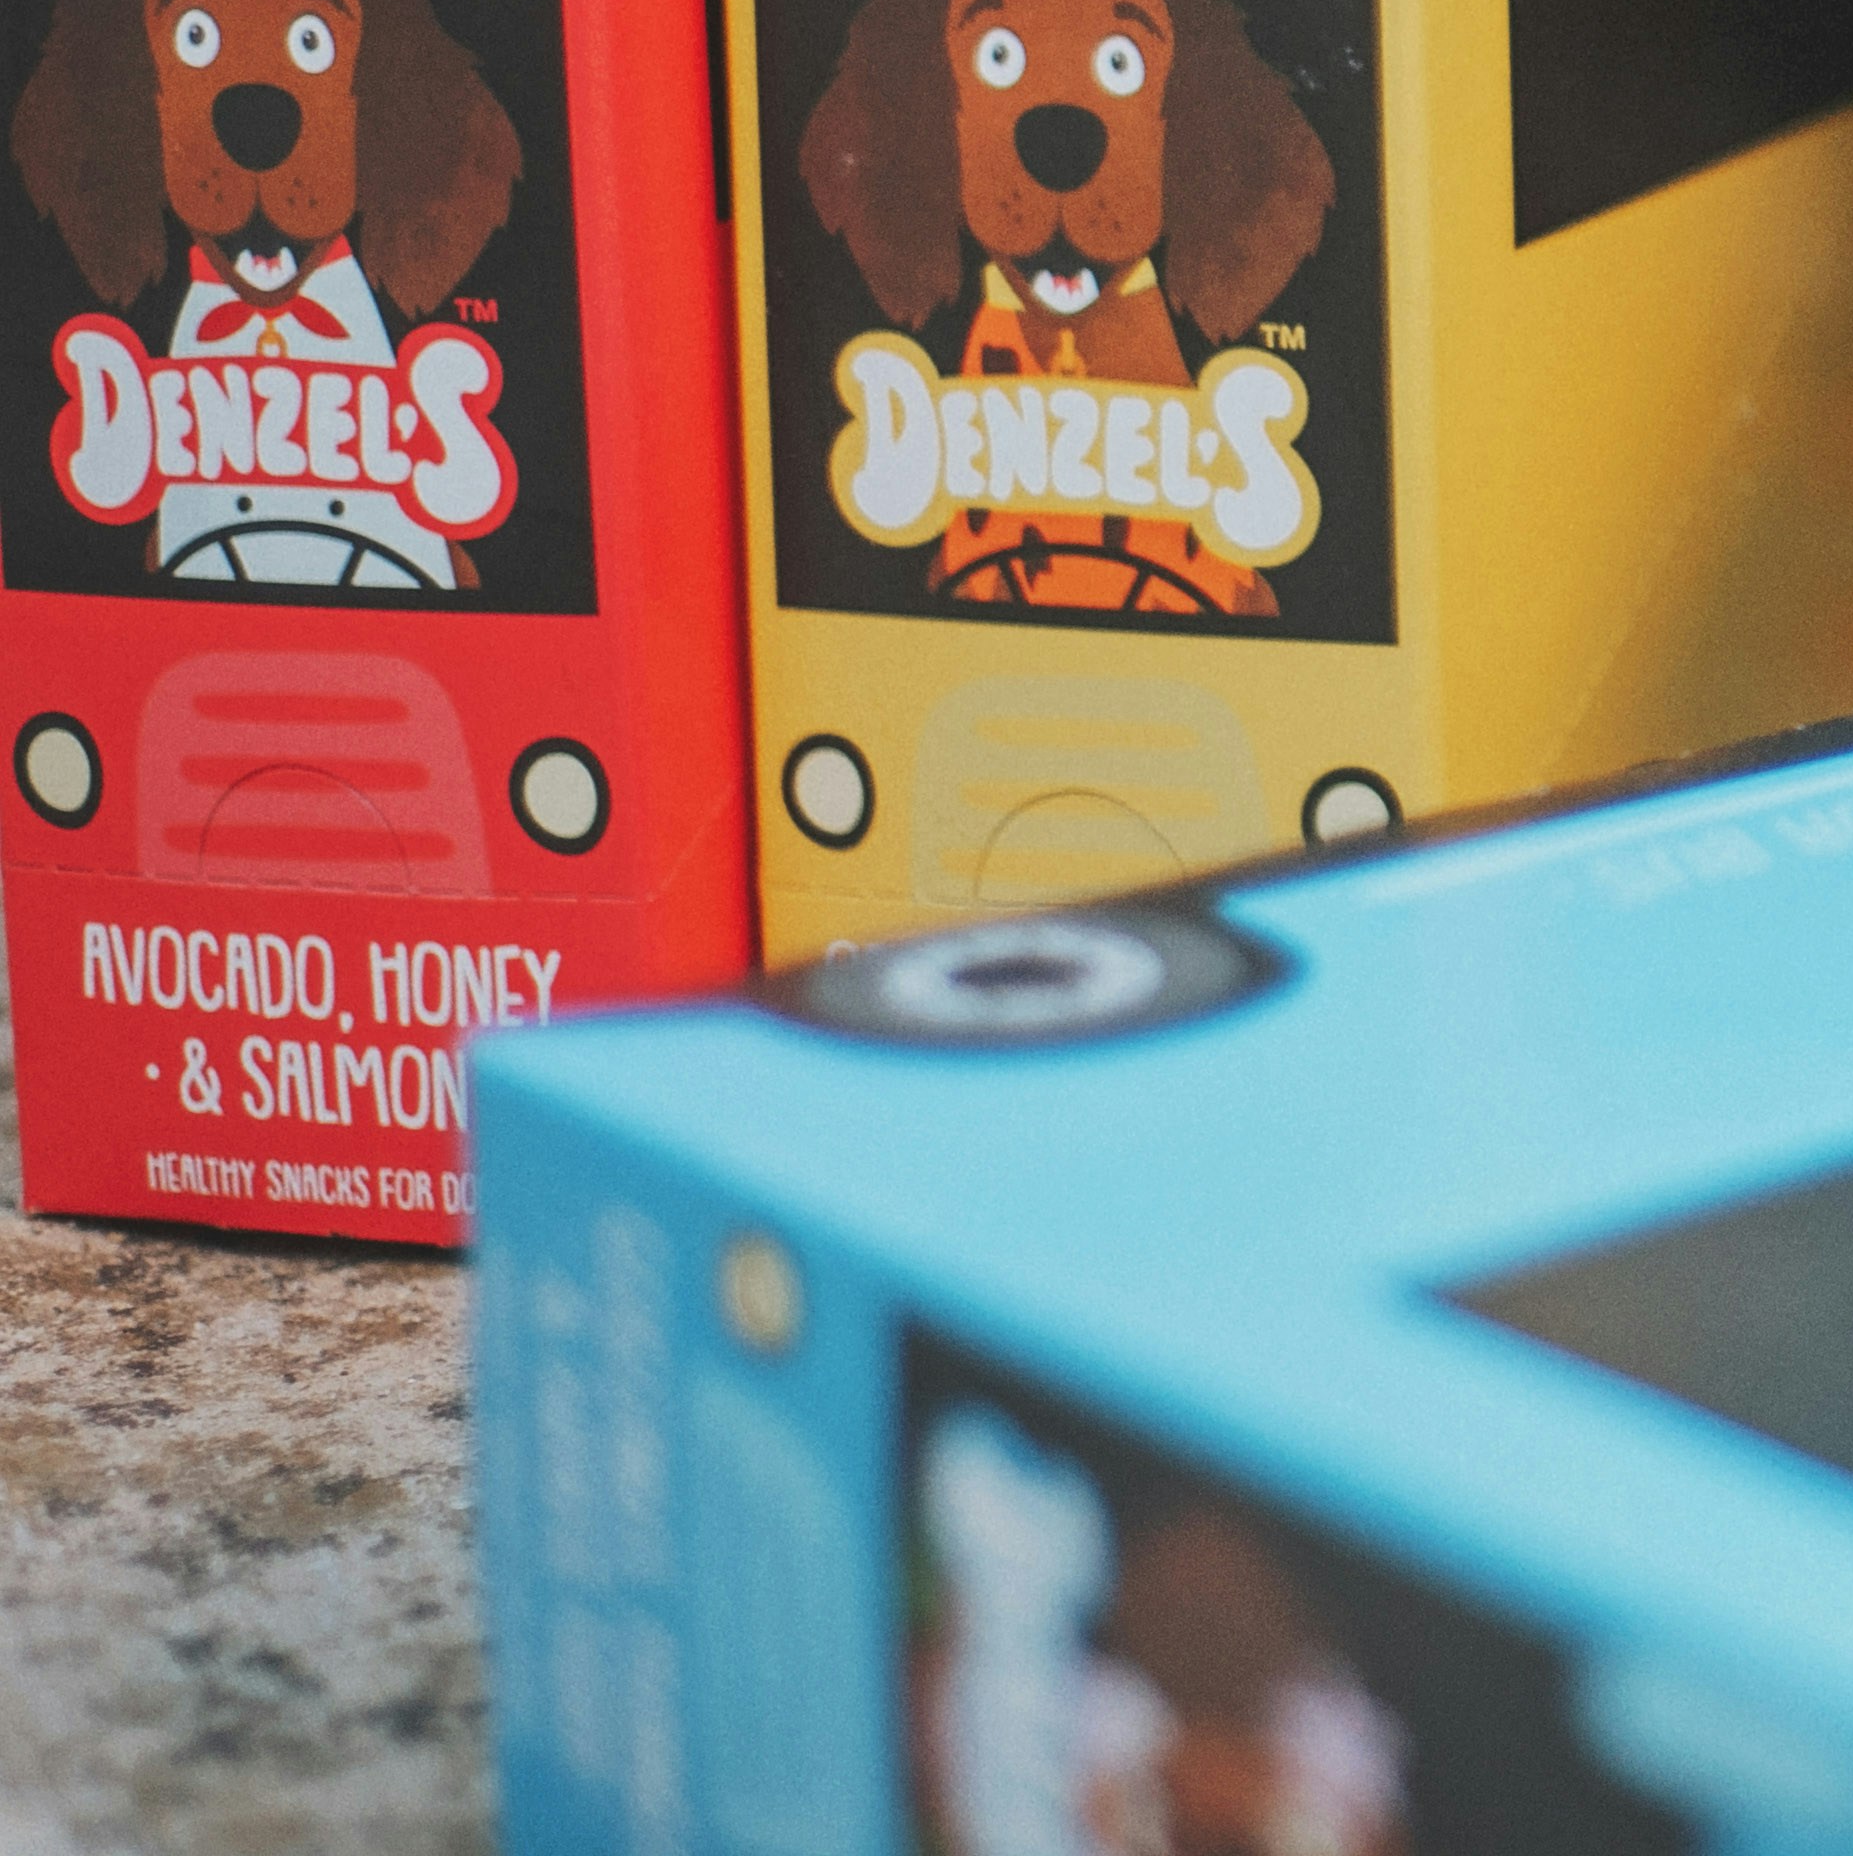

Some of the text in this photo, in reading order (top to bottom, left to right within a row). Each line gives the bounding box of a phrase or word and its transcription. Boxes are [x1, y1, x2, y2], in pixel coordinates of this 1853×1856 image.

[453, 296, 499, 323] TM
[1260, 322, 1307, 351] TM
[64, 328, 504, 527] DENZEL'S
[848, 347, 1304, 552] DENZEL'S
[81, 921, 563, 1034] AVOCADO, HONEY
[178, 1034, 469, 1134] & SALMON
[146, 1151, 479, 1217] HEALTHY SNACKS FOR DO
